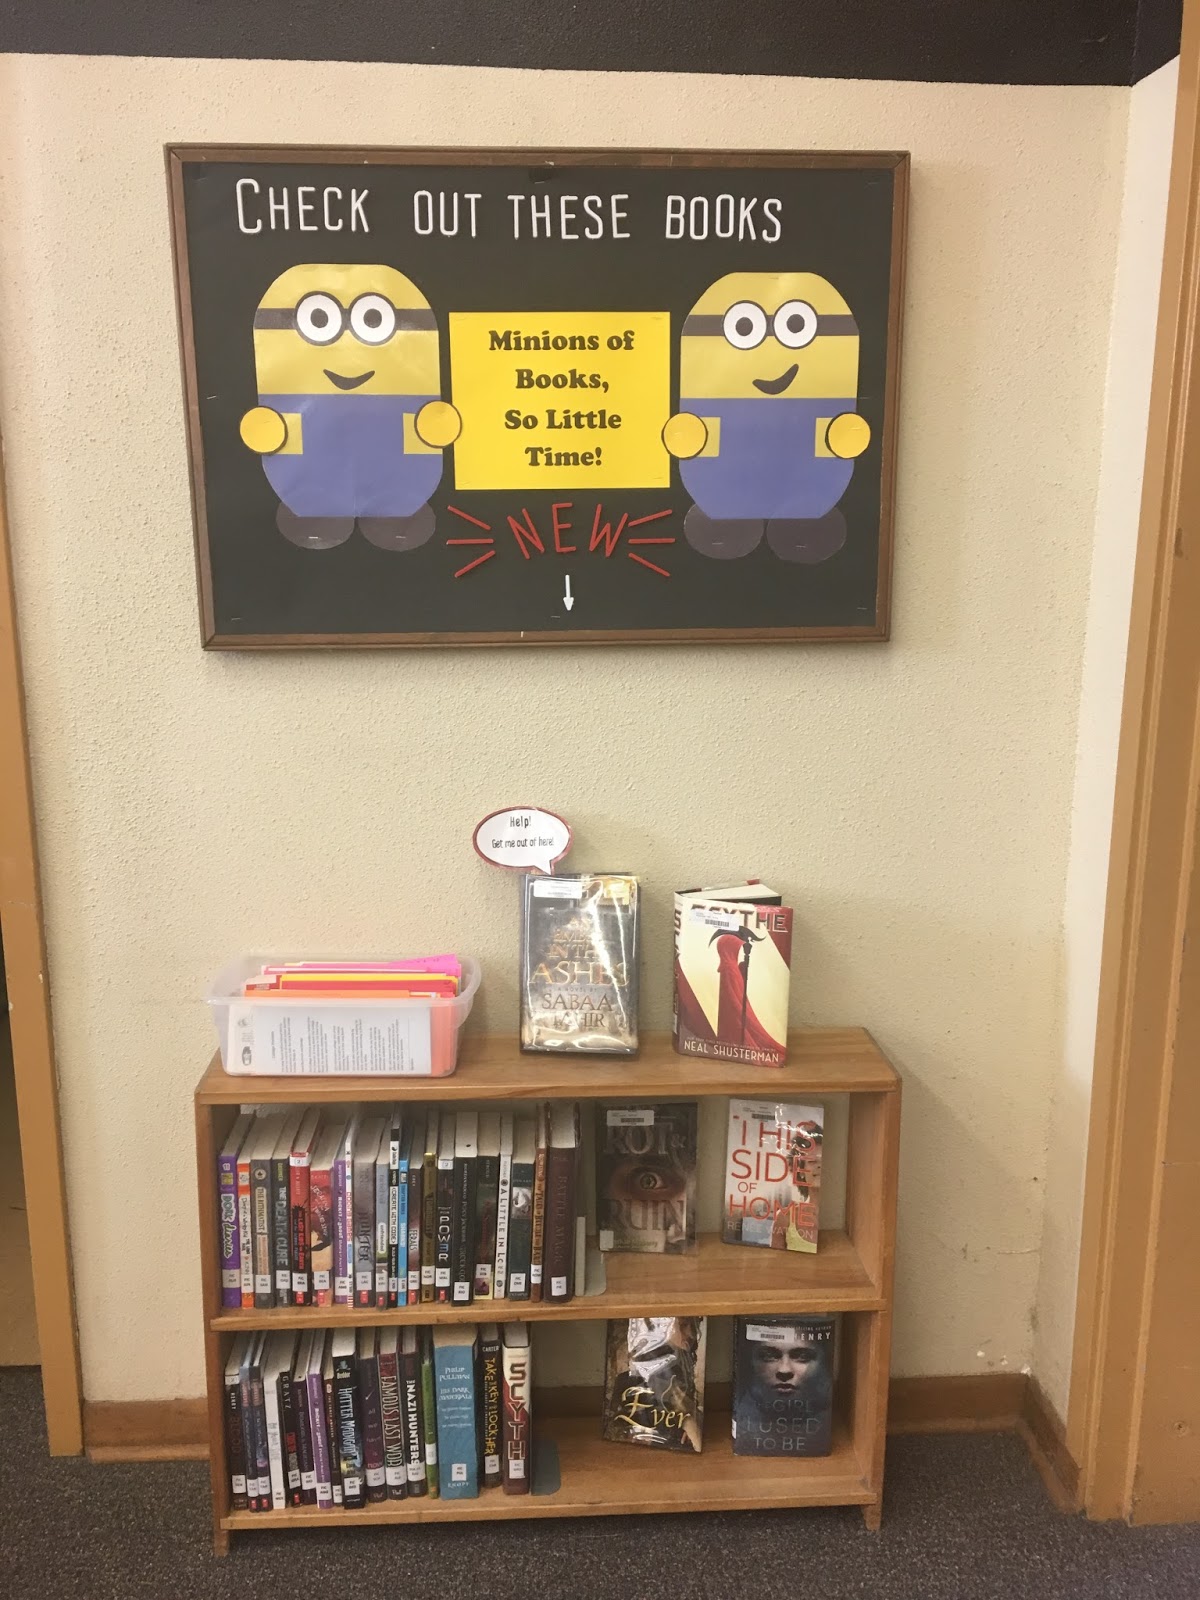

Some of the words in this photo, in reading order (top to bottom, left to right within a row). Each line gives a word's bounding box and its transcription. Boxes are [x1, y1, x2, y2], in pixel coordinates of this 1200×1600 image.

[236, 178, 370, 235] CHECK
[413, 190, 482, 237] OUT
[507, 194, 631, 239] THESE
[665, 193, 783, 242] BOOKS
[488, 329, 599, 352] Minions
[606, 329, 635, 353] of
[515, 369, 610, 393] Books,
[504, 410, 538, 431] So
[546, 408, 622, 430] Little
[524, 446, 603, 467] Time!
[507, 503, 628, 559] NEW
[510, 815, 532, 828] Help!
[491, 839, 503, 848] Get
[504, 840, 515, 848] me
[516, 838, 528, 848] out
[529, 837, 537, 847] of
[538, 836, 554, 846] here!
[528, 960, 630, 987] ASHES
[541, 992, 613, 1012] SABAA
[684, 1039, 709, 1054] NEAL
[713, 1045, 780, 1064] SHUSTERMAN
[733, 1115, 818, 1153] THIS
[731, 1149, 814, 1187] SIDE
[737, 1181, 758, 1194] OF
[221, 1194, 234, 1222] DORK
[275, 1200, 287, 1236] DEATH
[498, 1198, 508, 1232] LITTLE
[728, 1194, 817, 1227] HOME
[222, 1223, 236, 1258] diaries
[358, 1212, 370, 1262] HUNTER
[409, 1229, 418, 1251] FERALS
[498, 1237, 505, 1248] IN
[276, 1237, 288, 1266] CURE
[439, 1374, 470, 1382] PULLMAN
[484, 1358, 497, 1382] TAKE
[282, 1375, 291, 1409] GRATZ
[337, 1386, 354, 1419] HATTER
[381, 1375, 400, 1420] FAMOUS
[406, 1384, 418, 1412] NAZI
[488, 1386, 499, 1404] KEY
[507, 1361, 527, 1460] SCYTH
[613, 1386, 692, 1431] Ever
[384, 1419, 401, 1441] LAST
[488, 1410, 499, 1437] LOCK
[759, 1416, 821, 1435] USED
[340, 1420, 357, 1457] MADIGAN
[484, 1437, 496, 1455] HER
[754, 1437, 777, 1450] TO
[781, 1436, 807, 1452] BE
[386, 1444, 403, 1468] WOR
